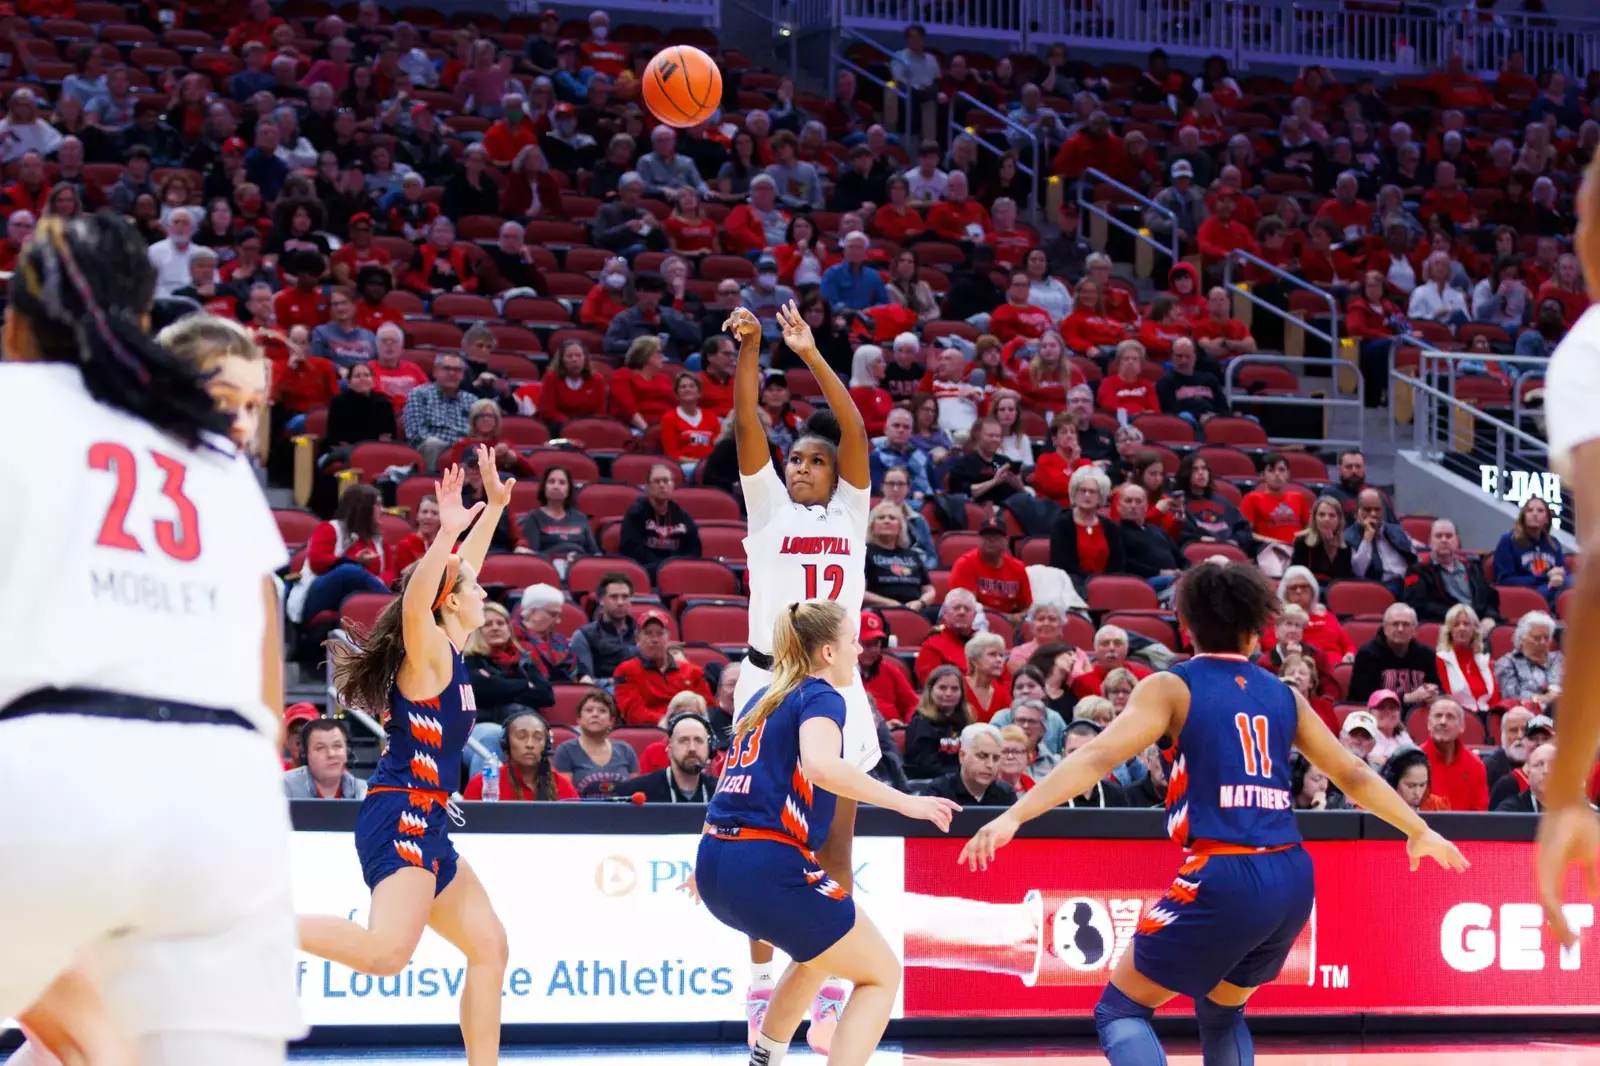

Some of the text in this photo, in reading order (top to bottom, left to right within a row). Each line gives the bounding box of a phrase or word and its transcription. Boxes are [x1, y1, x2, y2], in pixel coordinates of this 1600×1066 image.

[88, 441, 202, 563] 23
[779, 536, 851, 556] LOUISVILL
[89, 569, 219, 614] MOBLEY
[801, 564, 844, 601] 12
[727, 716, 767, 768] 33
[1235, 712, 1272, 778] 11
[1220, 785, 1290, 809] MATTHEWS
[1440, 902, 1594, 972] GET
[323, 960, 532, 997] Louisve
[546, 959, 733, 996] Athletics
[1319, 964, 1349, 989] TM
